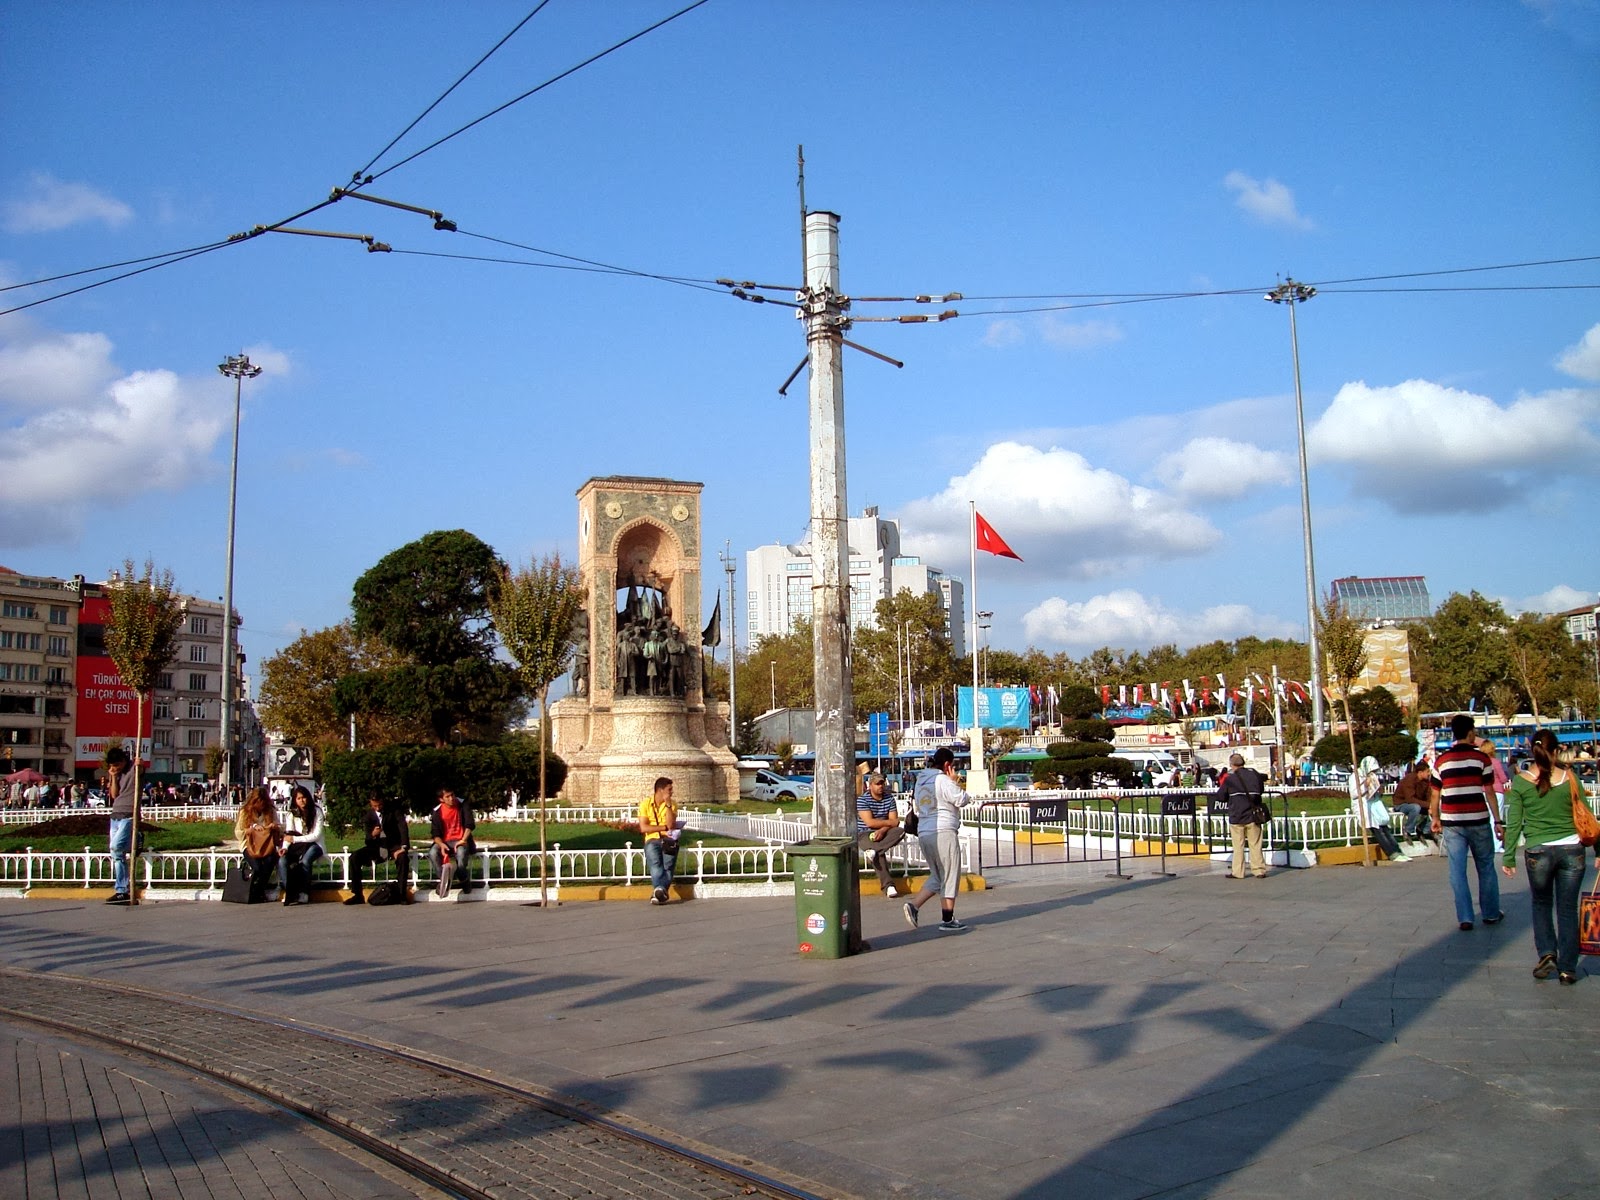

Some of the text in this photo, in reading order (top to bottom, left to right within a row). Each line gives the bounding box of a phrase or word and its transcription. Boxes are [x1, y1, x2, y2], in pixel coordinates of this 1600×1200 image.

[85, 688, 96, 698] EN
[98, 689, 114, 701] ÇOK
[105, 701, 130, 713] SİTESİ
